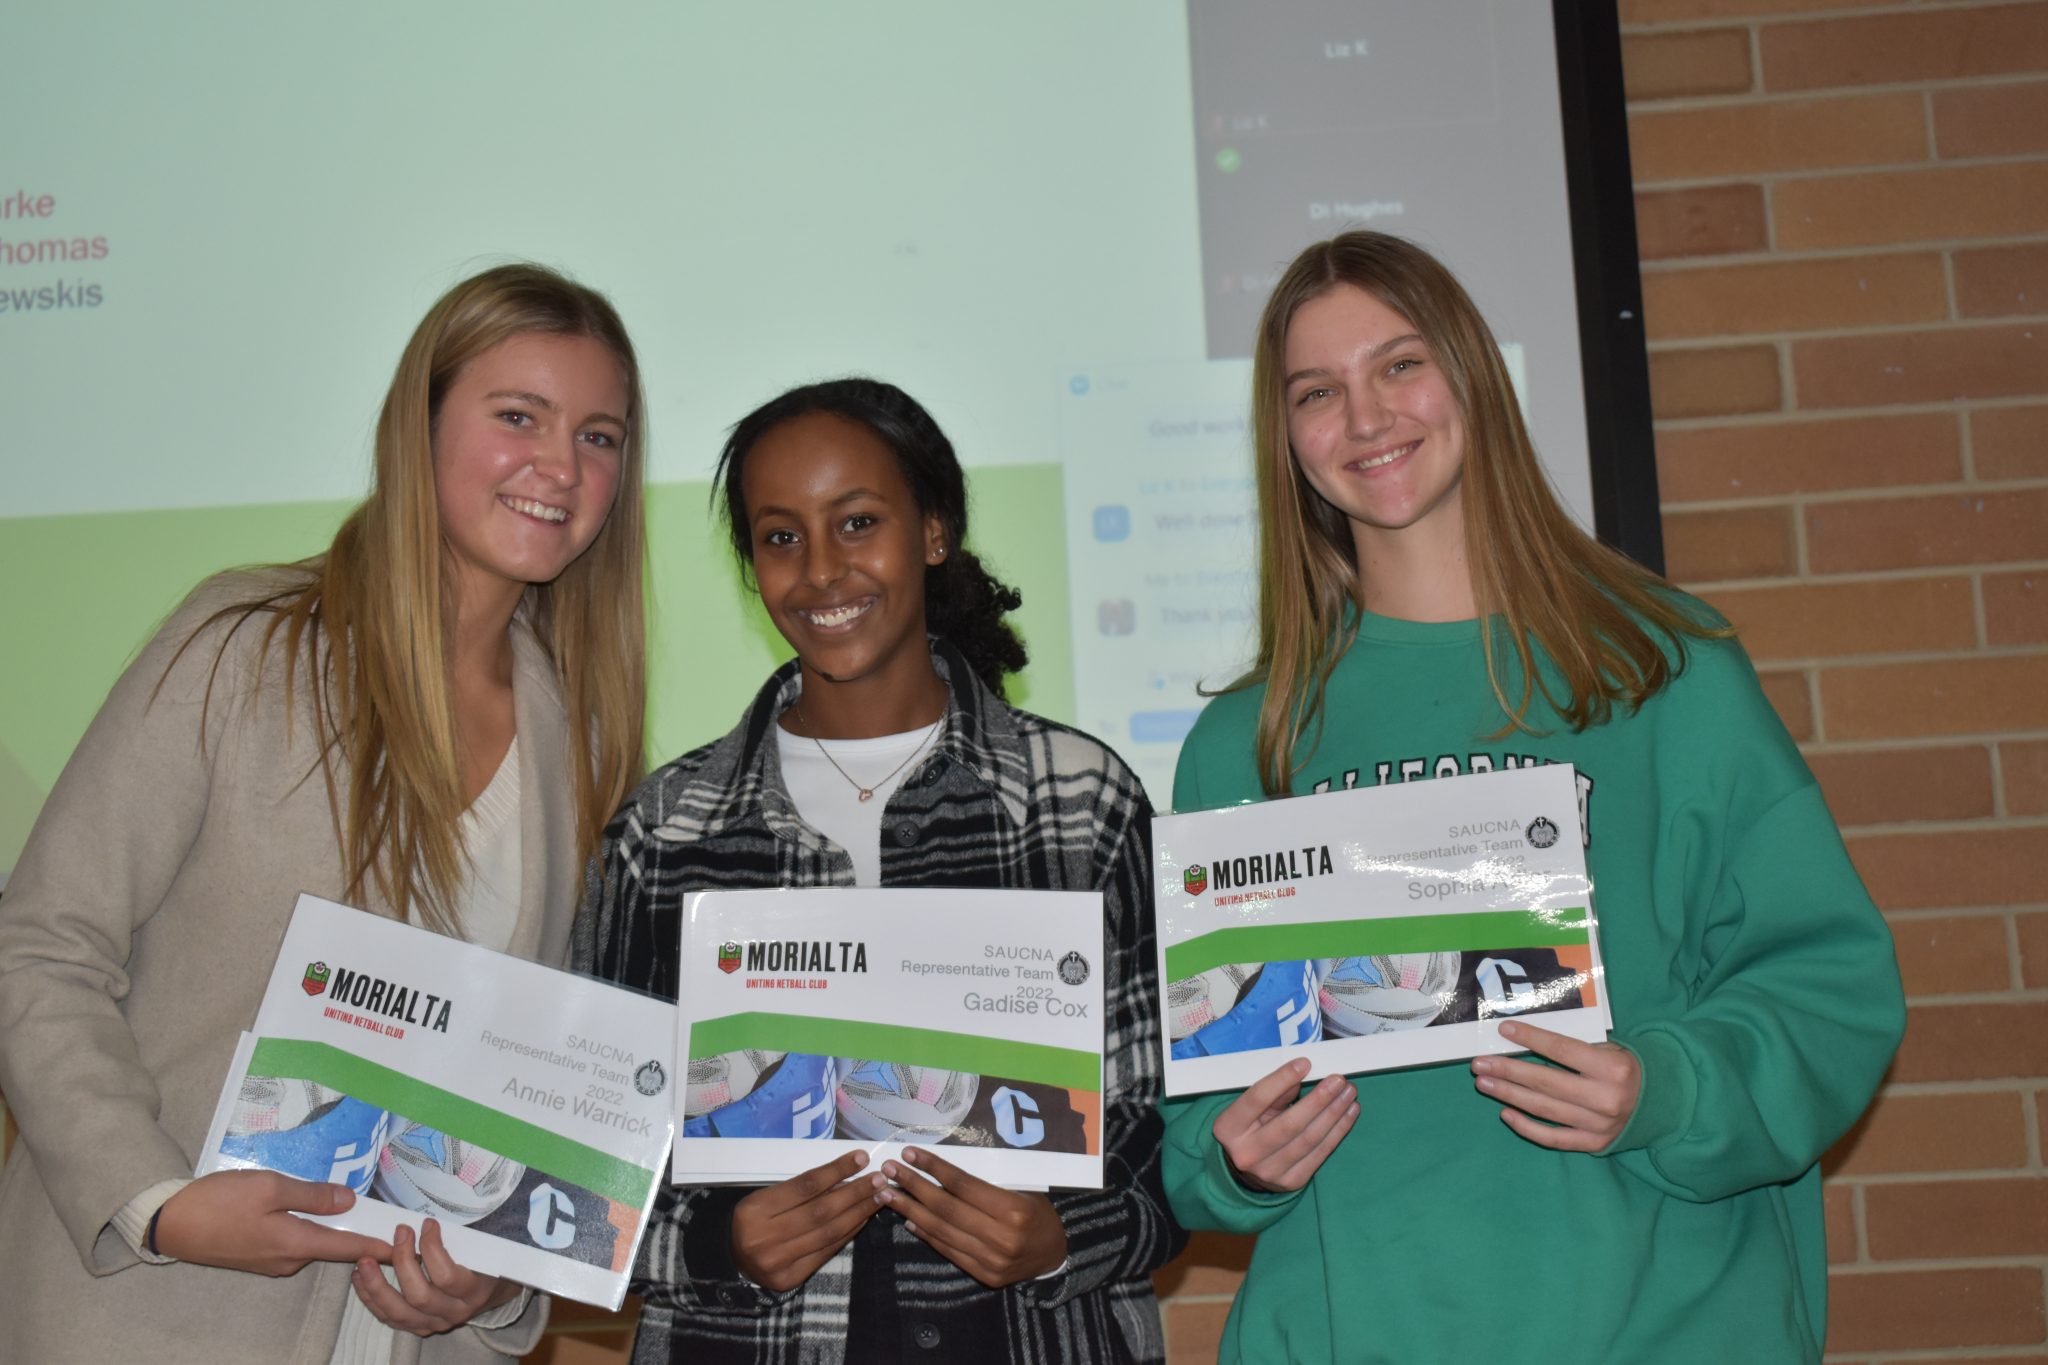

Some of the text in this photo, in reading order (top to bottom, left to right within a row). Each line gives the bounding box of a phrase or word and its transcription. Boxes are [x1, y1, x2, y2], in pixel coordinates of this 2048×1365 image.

[0, 189, 55, 219] rke
[1334, 200, 1405, 219] Hughes
[1448, 819, 1522, 838] SAUCNA
[1484, 838, 1523, 852] Team
[1213, 845, 1334, 890] MORIALTA
[747, 941, 867, 973] MORIALTA
[984, 945, 1054, 961] SAUCNA
[901, 960, 1054, 981] Representative Team
[746, 979, 828, 989] UNITING NETBALL CLUB
[1016, 985, 1054, 1000] 2022
[330, 968, 452, 1033] MORIALTA
[963, 992, 1088, 1018] Gadise Cox
[324, 1007, 404, 1039] UNITING NETBALL CLUB
[480, 1030, 629, 1086] Representative Team
[566, 1034, 635, 1066] SAUCNA
[502, 1077, 653, 1137] Annie Warrick
[585, 1084, 624, 1106] 2022
